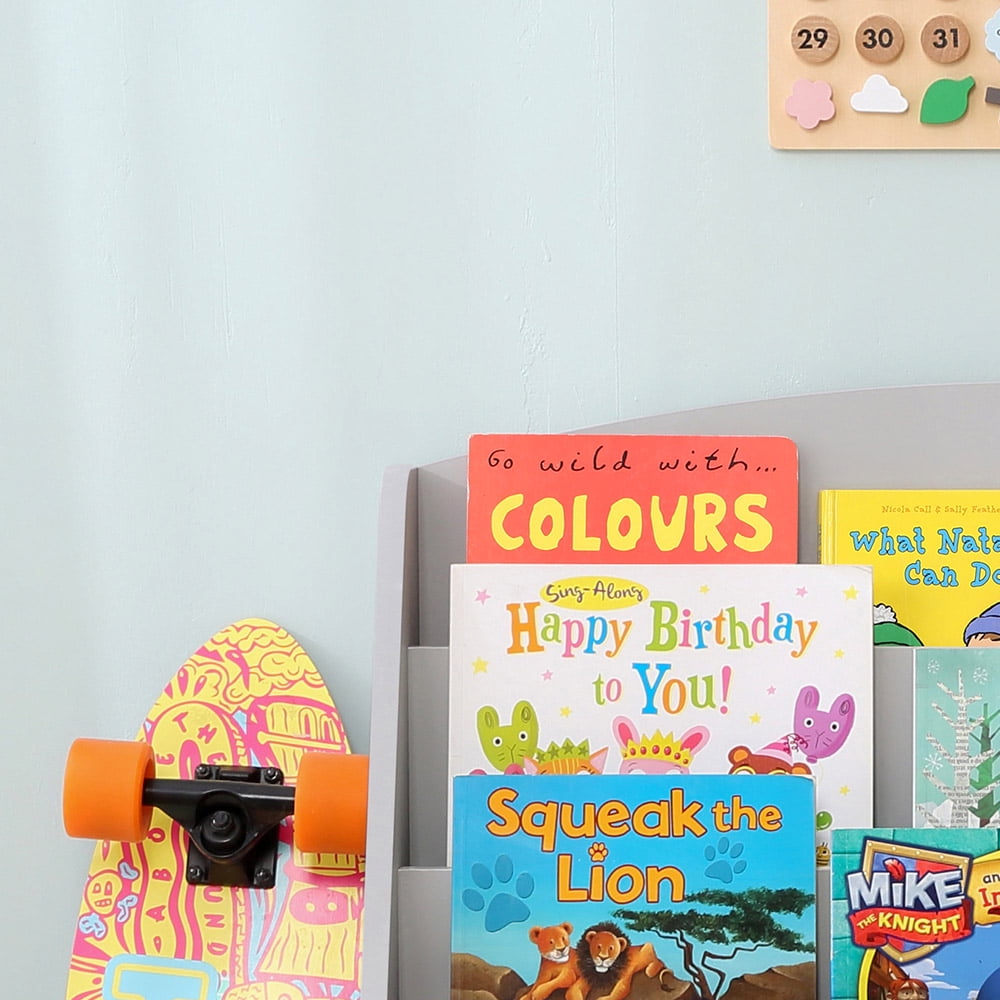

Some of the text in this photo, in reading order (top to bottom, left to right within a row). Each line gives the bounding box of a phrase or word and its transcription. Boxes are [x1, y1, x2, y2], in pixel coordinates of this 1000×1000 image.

[797, 28, 828, 49] 29
[862, 28, 894, 49] 30
[932, 28, 960, 49] 31
[488, 446, 777, 472] Go wild with...
[491, 493, 773, 552] COLOURS
[881, 505, 911, 513] Nicola
[914, 505, 932, 513] Call
[944, 505, 968, 515] Sally
[849, 526, 926, 556] What
[904, 560, 959, 588] Can
[545, 581, 644, 604] Sing-Along
[506, 600, 820, 658] Happy Birthday
[592, 662, 734, 715] to You!
[485, 787, 783, 853] Squeak the
[556, 843, 687, 905] Lion
[856, 911, 962, 936] THE KNIGHT
